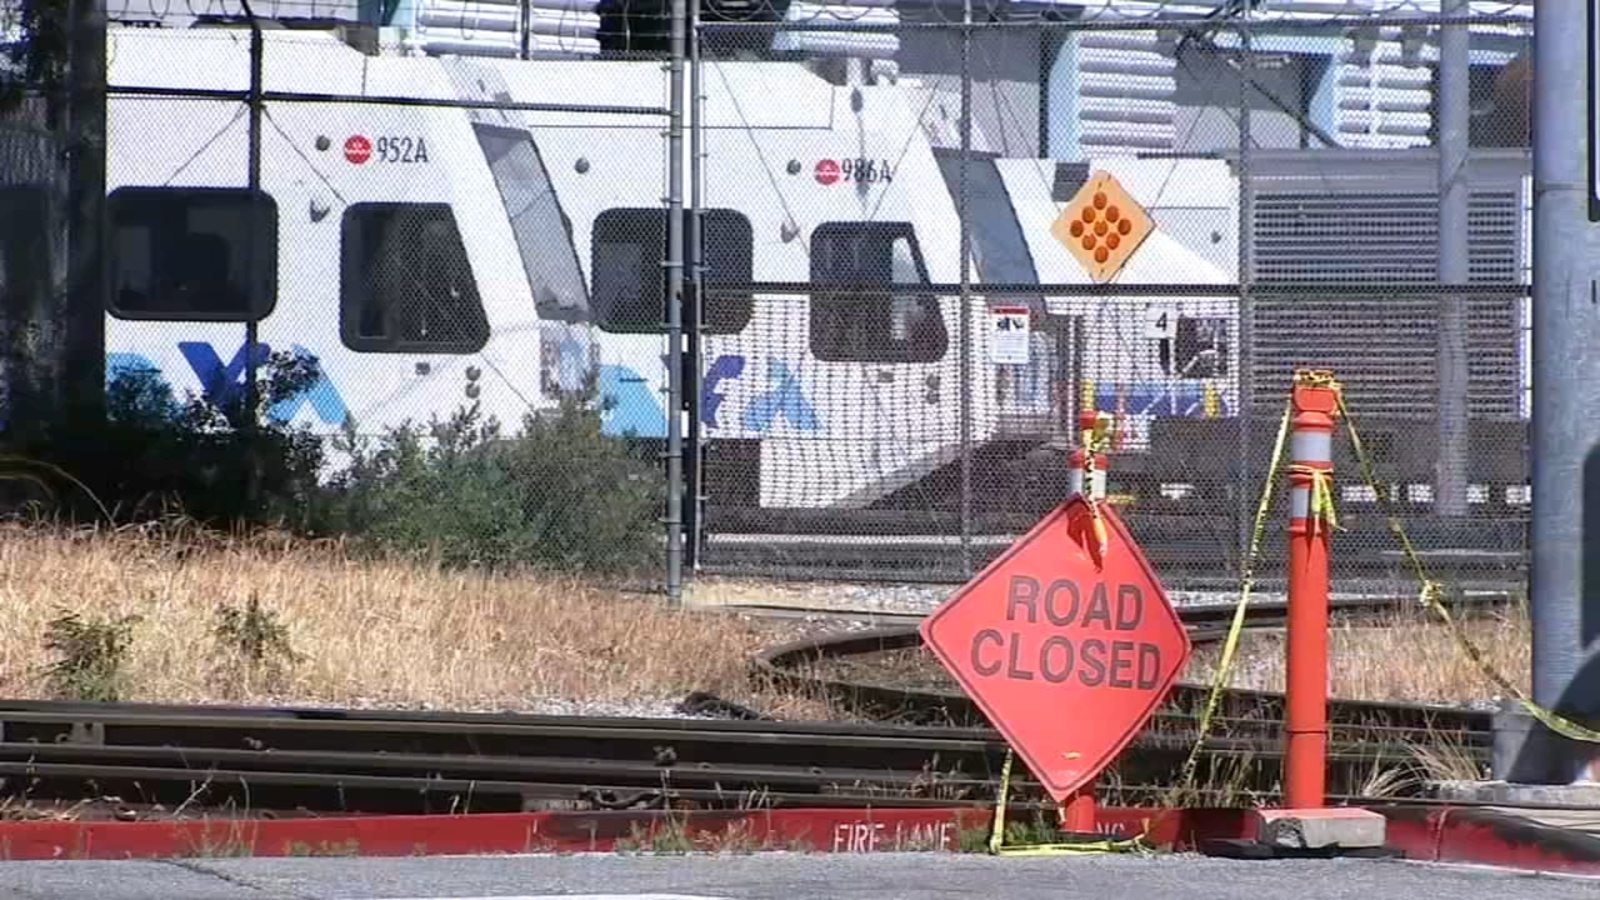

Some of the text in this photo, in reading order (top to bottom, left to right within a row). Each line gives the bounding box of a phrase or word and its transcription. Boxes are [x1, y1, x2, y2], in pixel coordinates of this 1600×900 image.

[376, 135, 429, 163] 952A
[841, 157, 893, 184] 986A
[1154, 311, 1168, 331] 4
[1006, 574, 1143, 631] ROAD
[970, 628, 1162, 690] CLOSED
